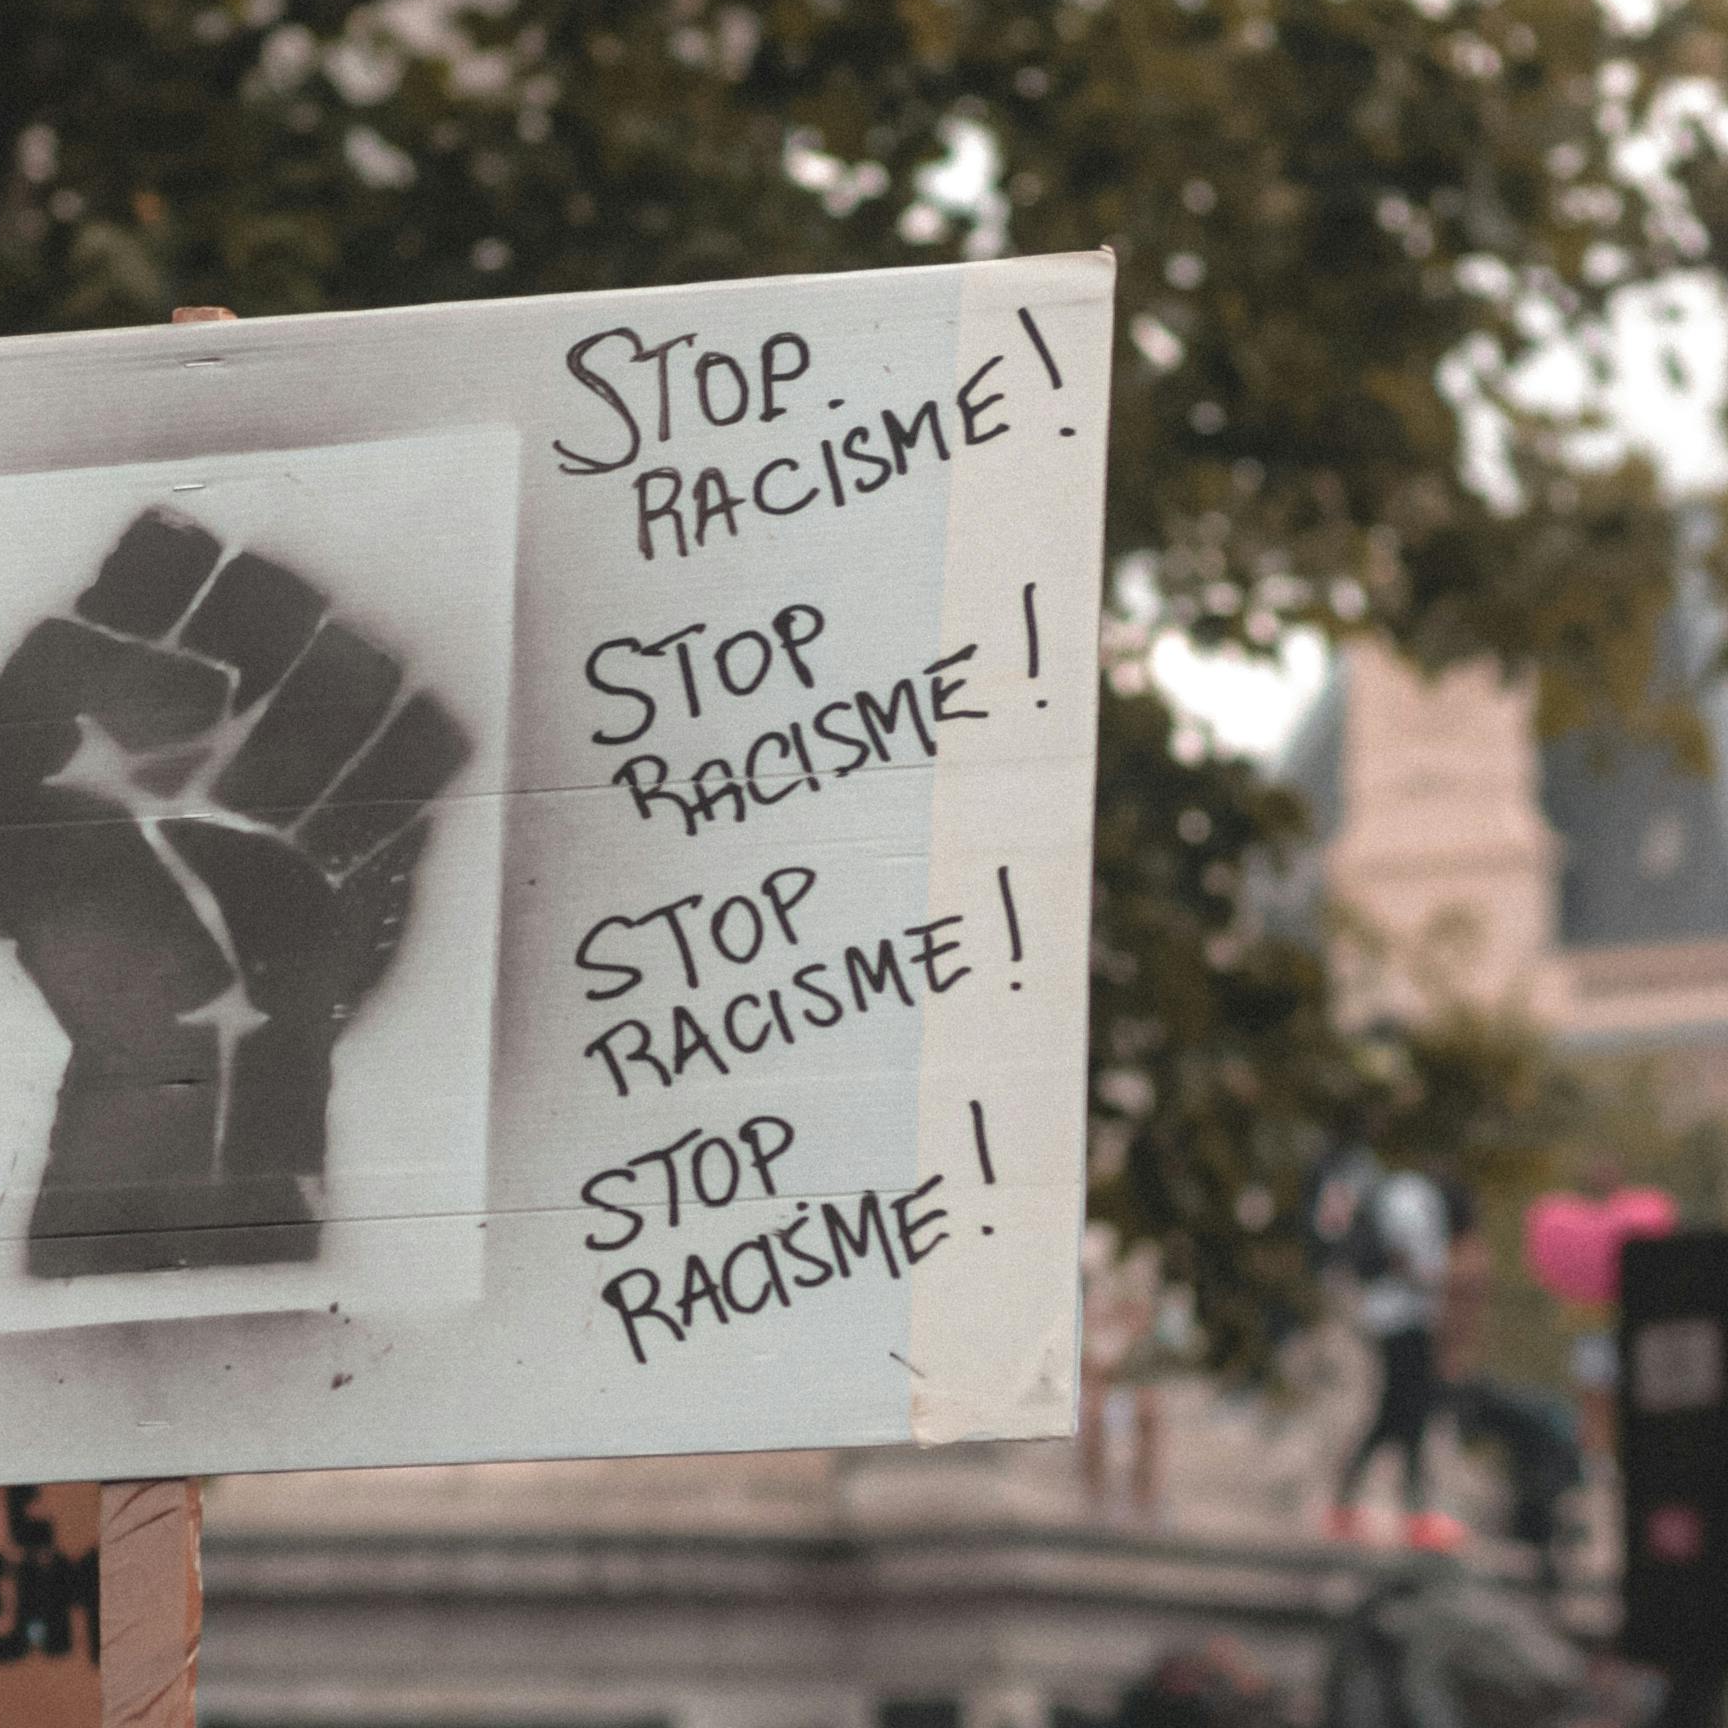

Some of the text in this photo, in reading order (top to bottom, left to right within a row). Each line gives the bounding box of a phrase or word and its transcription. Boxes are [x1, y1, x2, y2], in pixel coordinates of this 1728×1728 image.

[553, 326, 810, 474] STOP
[633, 307, 1077, 561] RACISME!
[585, 604, 826, 744] STOP
[612, 582, 1048, 836] RACISME!
[575, 867, 816, 1000] STOP
[584, 866, 1022, 1096] RACISME!
[580, 1115, 795, 1251] STOP
[601, 1100, 996, 1364] RACISME!
